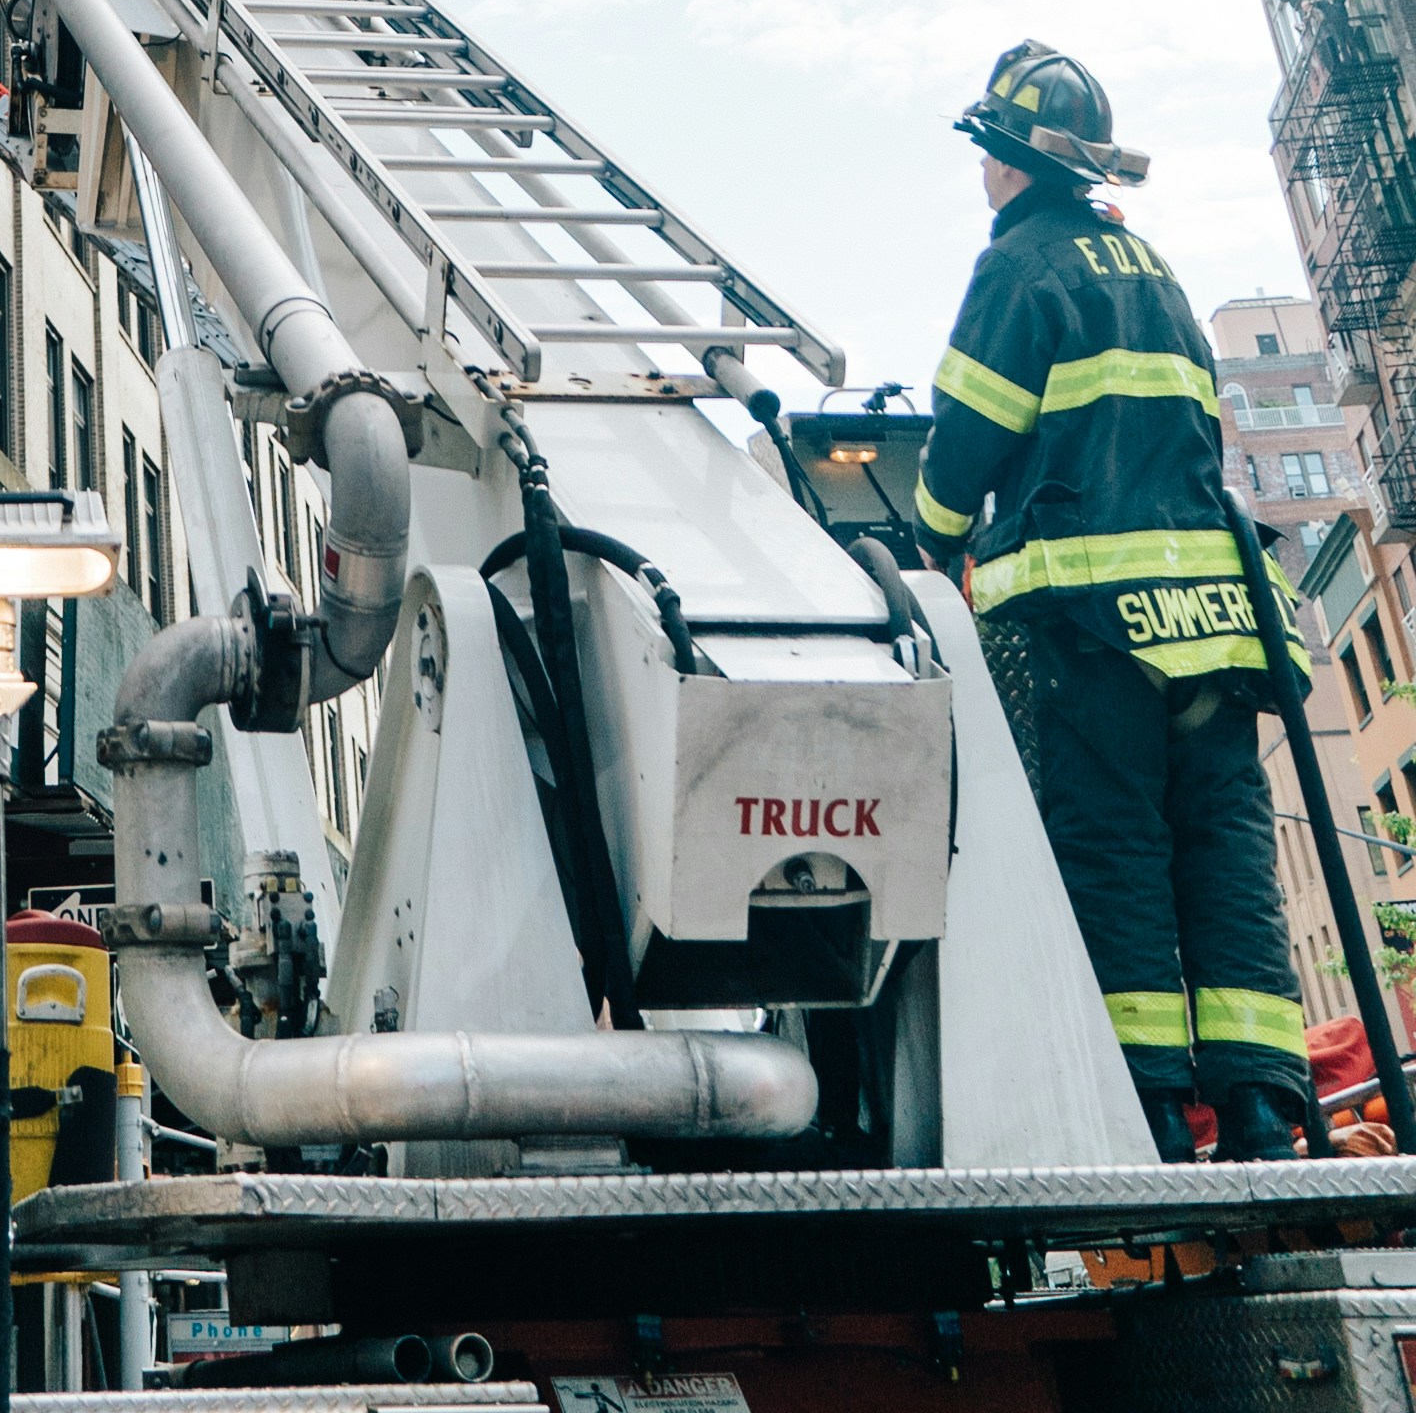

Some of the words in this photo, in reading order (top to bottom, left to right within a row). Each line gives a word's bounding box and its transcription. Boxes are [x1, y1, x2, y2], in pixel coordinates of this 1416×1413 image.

[735, 796, 882, 837] TRUCK
[191, 1322, 263, 1338] Phone
[646, 1376, 734, 1396] DANGER
